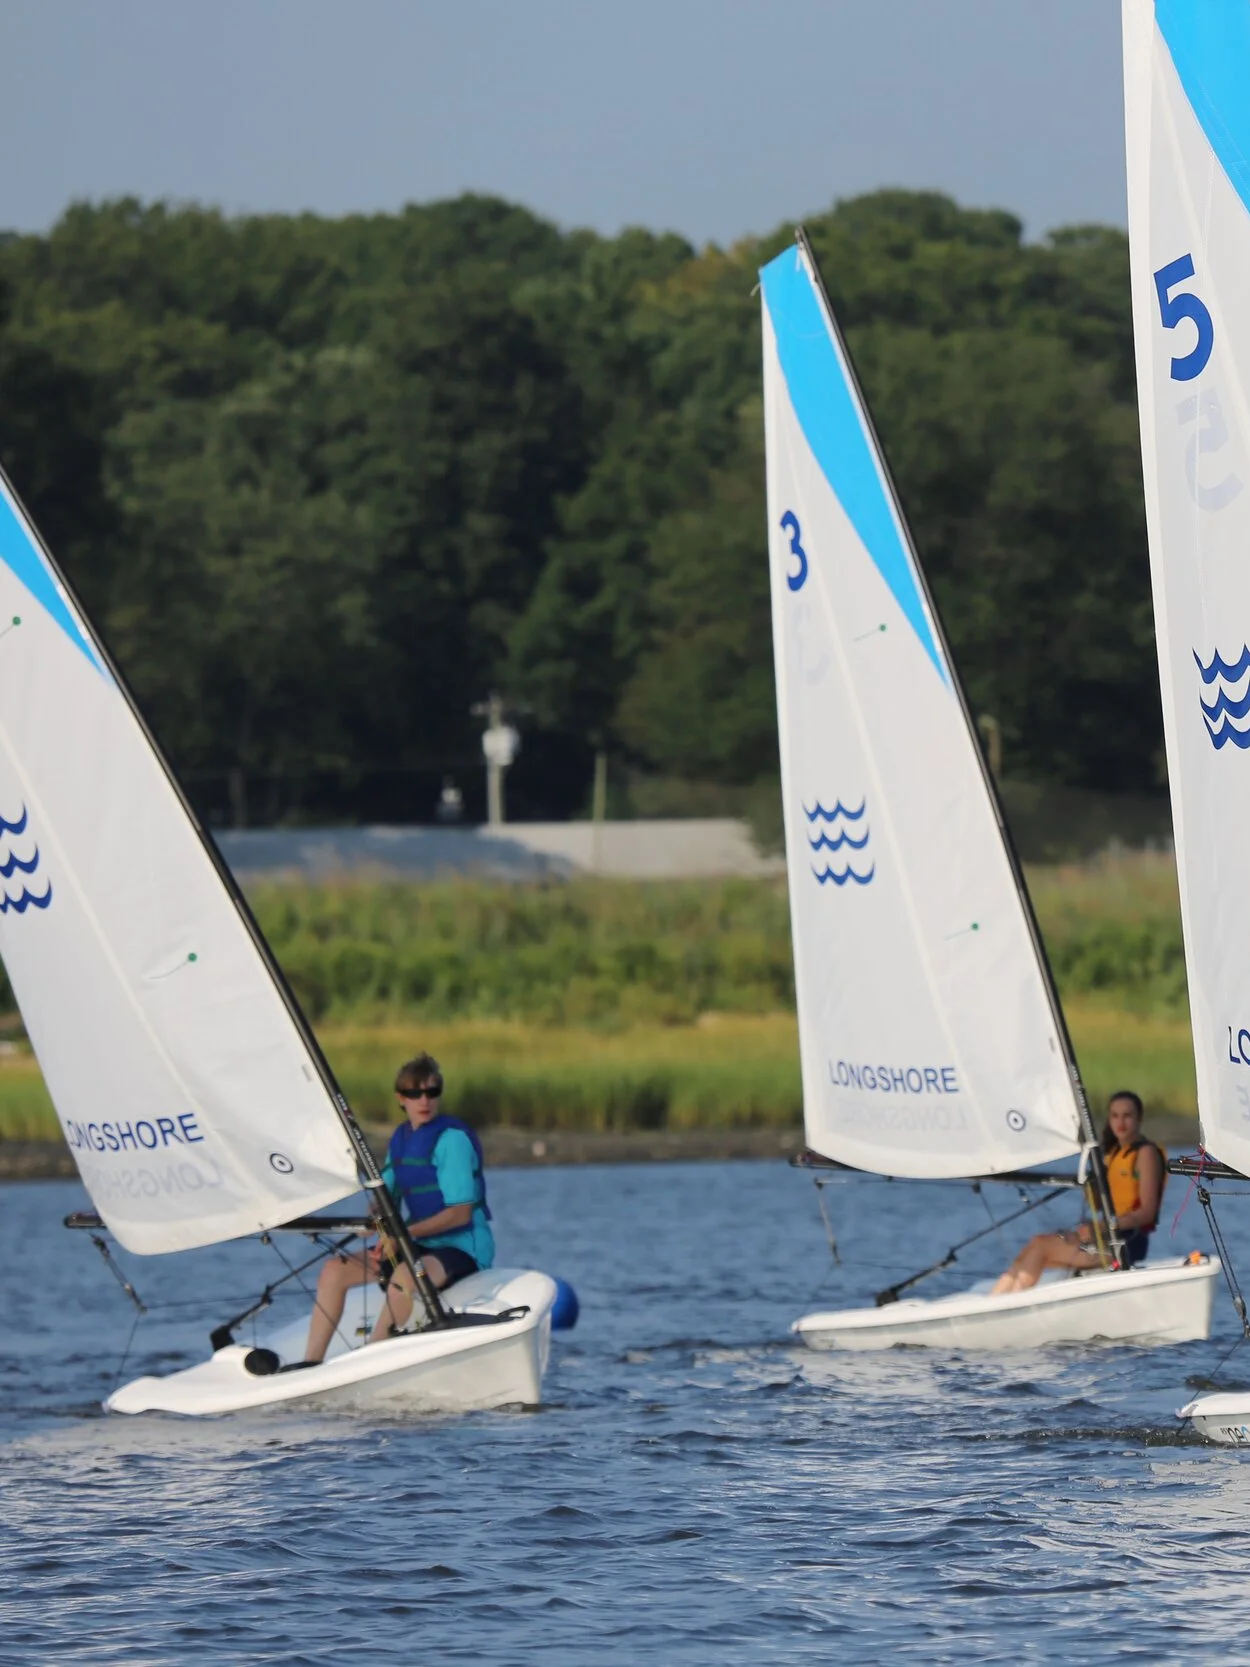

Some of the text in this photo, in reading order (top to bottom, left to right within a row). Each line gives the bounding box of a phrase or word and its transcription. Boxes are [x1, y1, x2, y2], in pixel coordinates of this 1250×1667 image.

[1153, 253, 1214, 381] 5
[779, 510, 809, 592] 3
[828, 1060, 959, 1094] LONGSHORE
